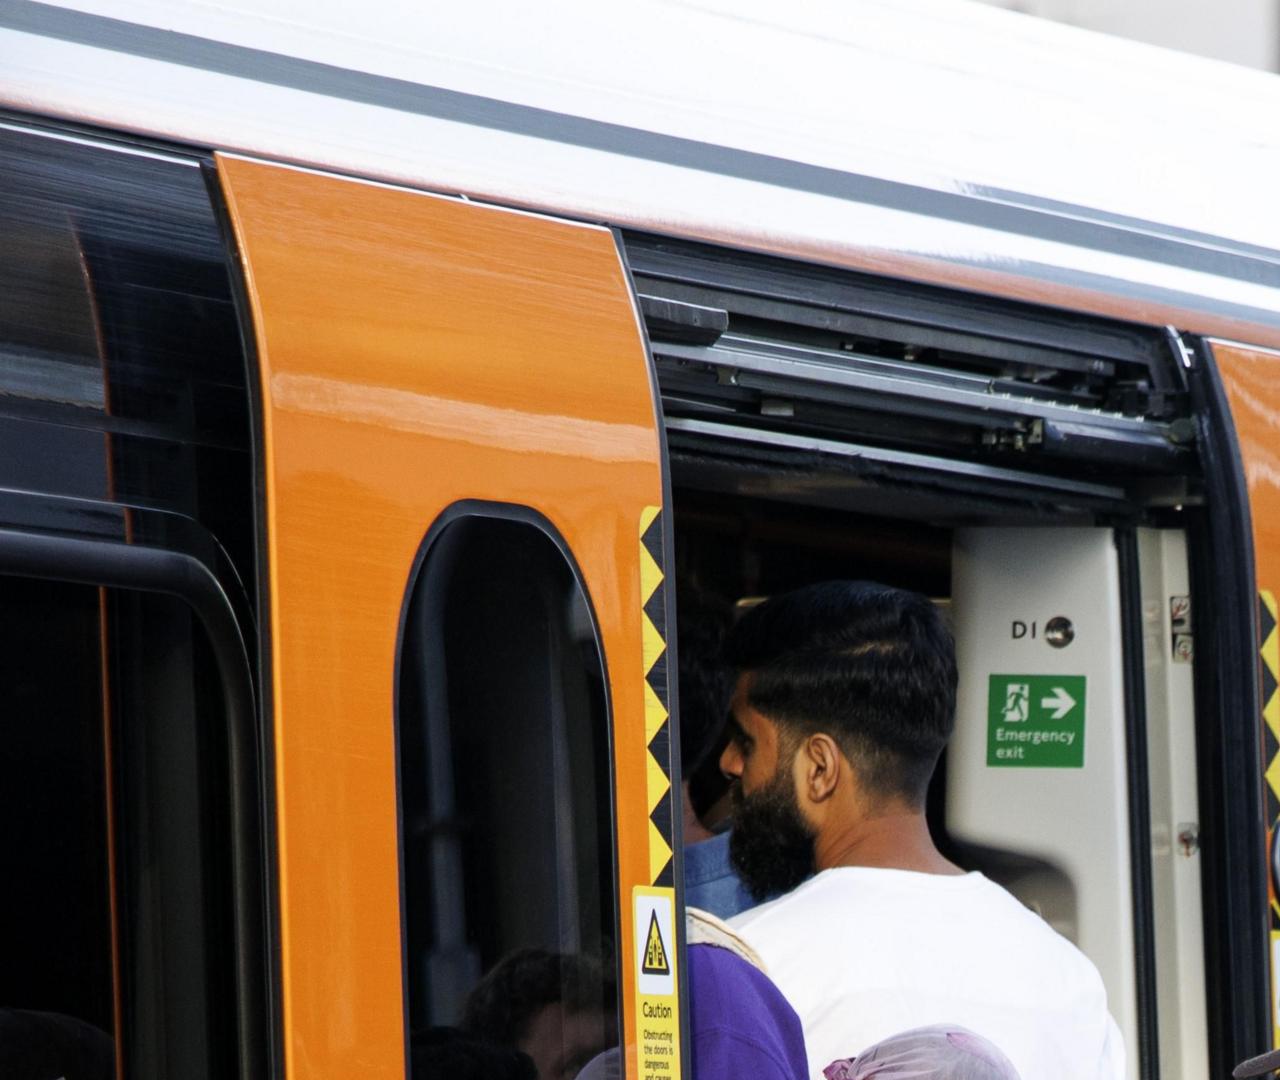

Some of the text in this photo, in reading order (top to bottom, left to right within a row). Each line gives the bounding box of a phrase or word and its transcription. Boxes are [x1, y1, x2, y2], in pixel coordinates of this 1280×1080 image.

[996, 728, 1075, 745] Emergency
[996, 746, 1024, 759] exit
[643, 1002, 672, 1018] Caution
[644, 1029, 673, 1043] Obstructing
[644, 1044, 652, 1055] the
[654, 1044, 667, 1055] doors
[645, 1059, 669, 1071] dangerous
